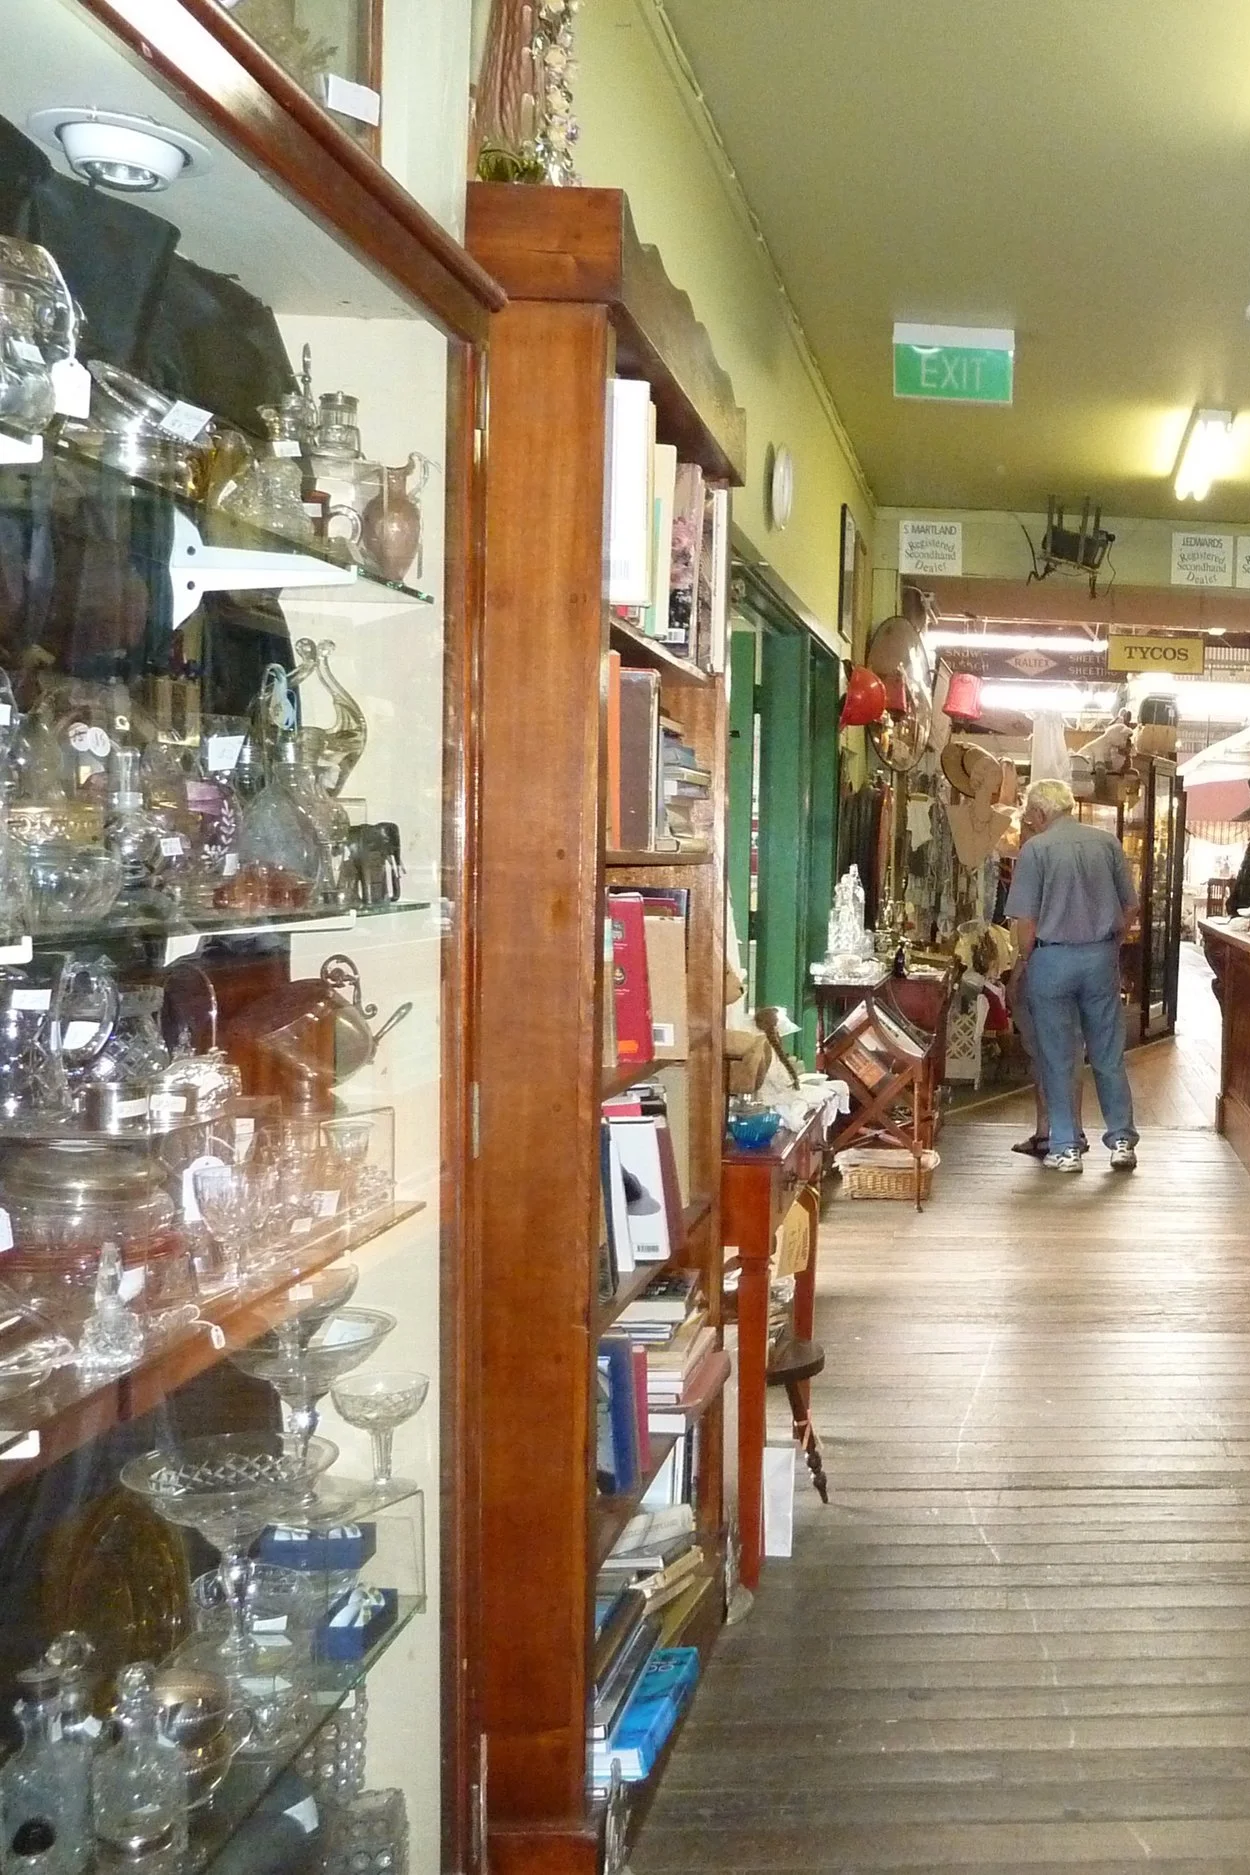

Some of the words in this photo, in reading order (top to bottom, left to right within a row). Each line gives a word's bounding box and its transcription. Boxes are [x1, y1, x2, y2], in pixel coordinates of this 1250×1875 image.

[921, 353, 987, 391] EXIT
[911, 524, 957, 535] MARTLAND
[907, 539, 956, 553] Registered
[904, 549, 957, 561] Secondhand
[1179, 551, 1227, 565] Registered
[914, 559, 947, 573] Dealer
[1176, 561, 1227, 573] Secondhand
[1186, 571, 1218, 585] Dealer
[1124, 645, 1189, 662] TYCOS
